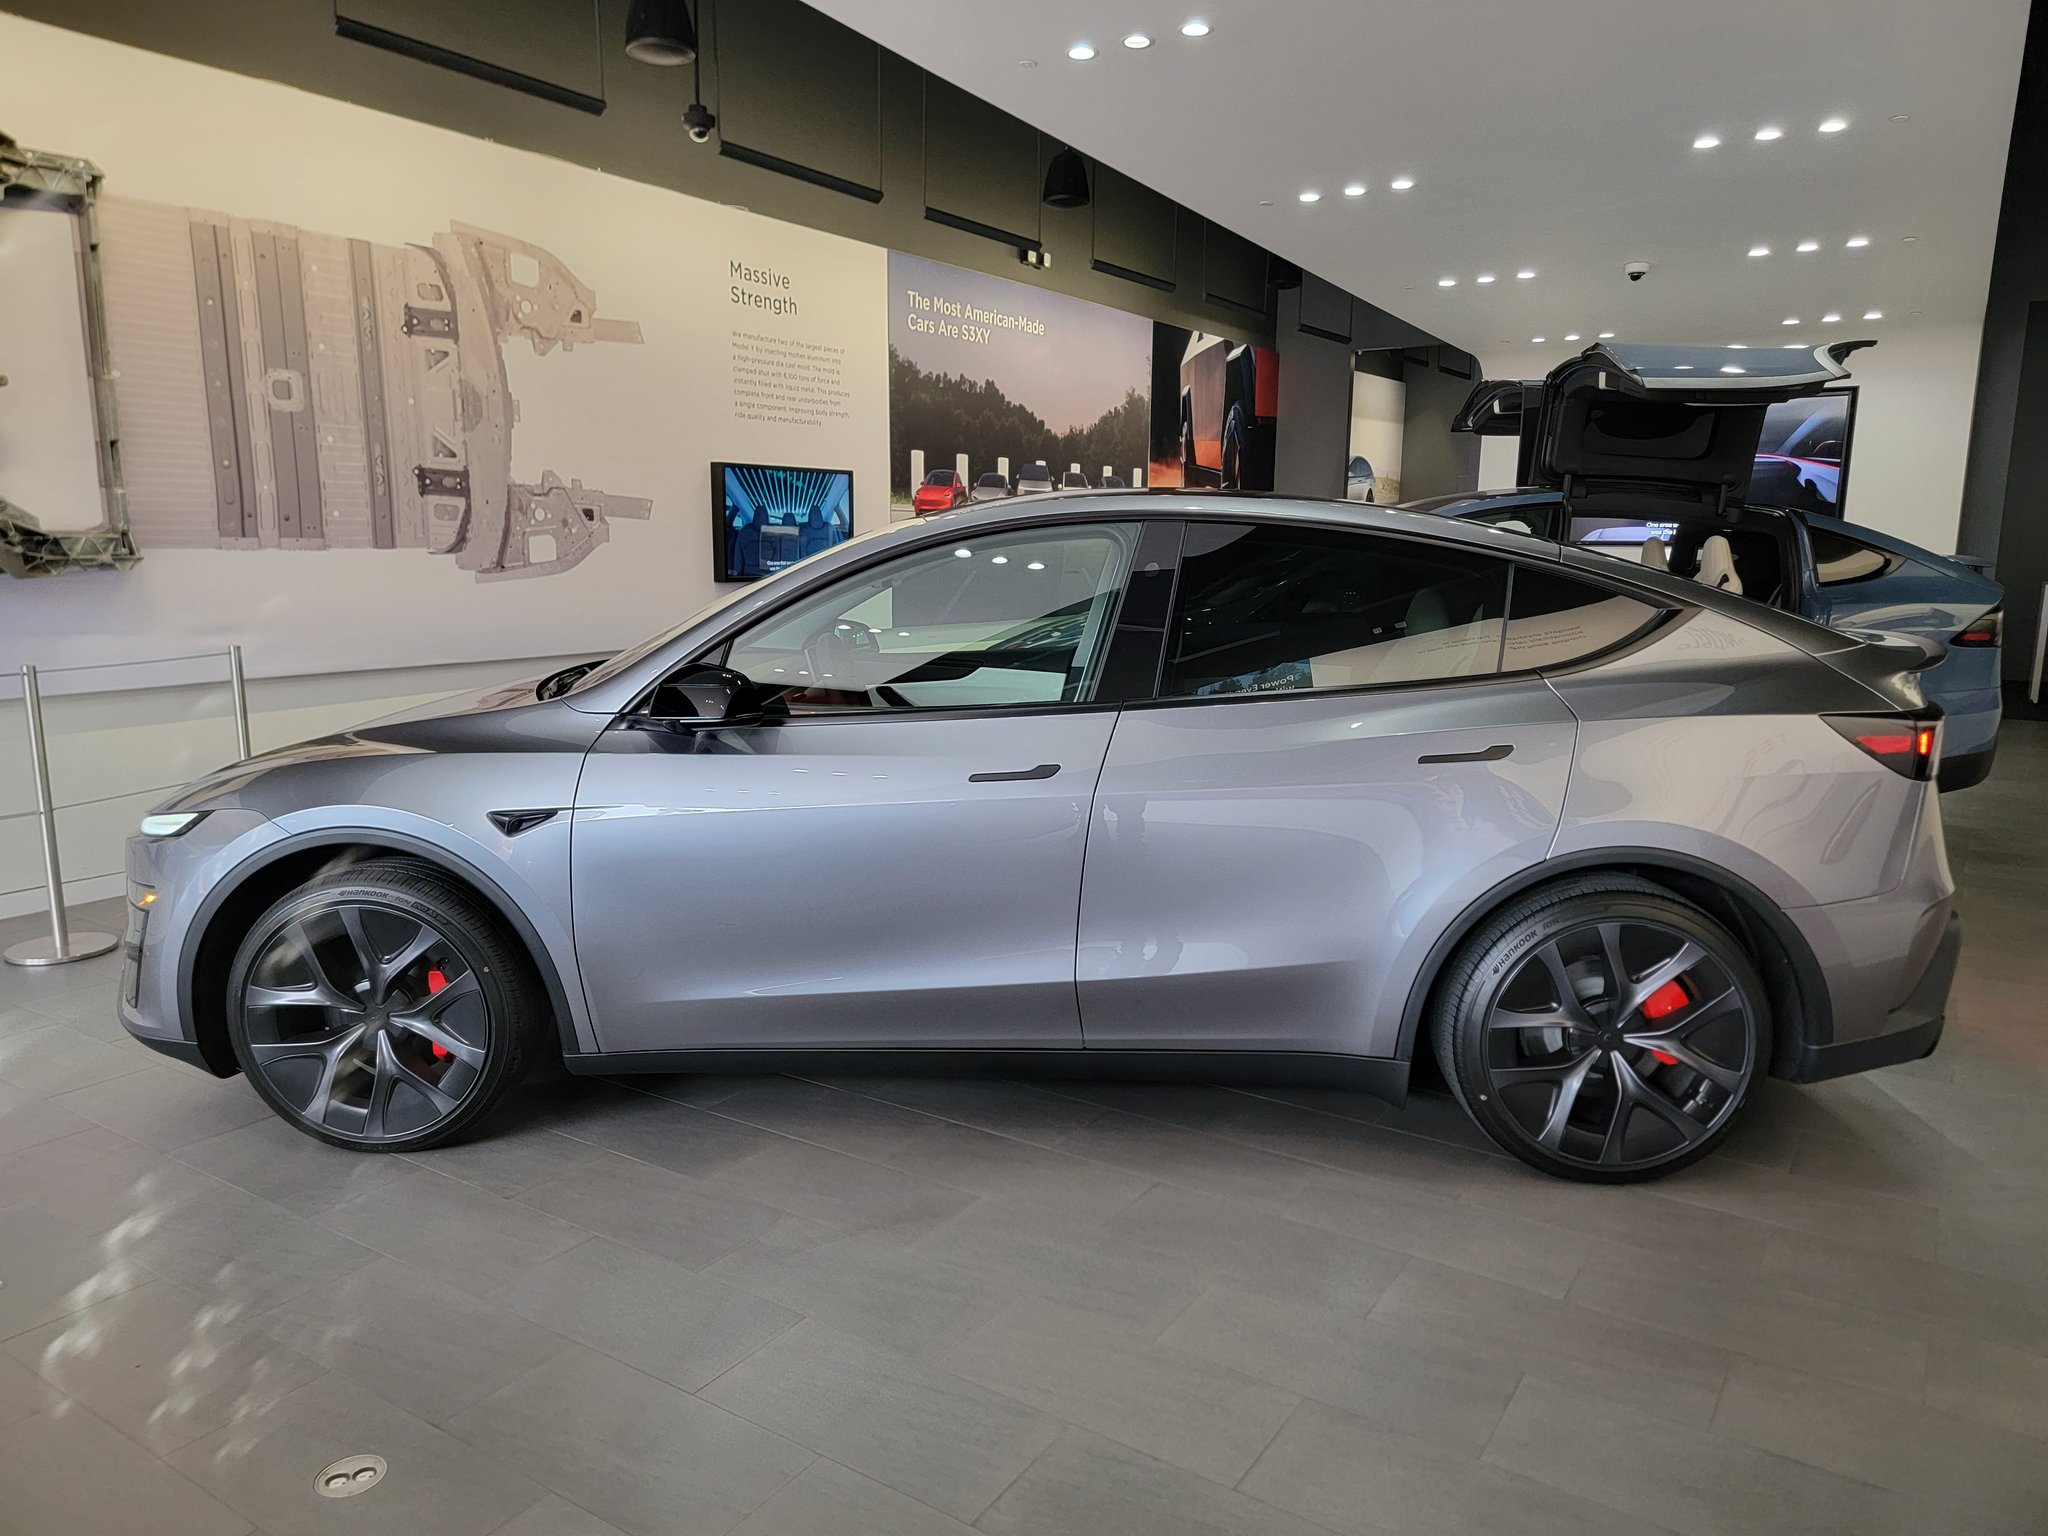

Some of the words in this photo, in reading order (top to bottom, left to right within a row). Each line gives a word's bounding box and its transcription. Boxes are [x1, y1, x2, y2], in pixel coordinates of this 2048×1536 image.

[730, 260, 790, 289] Massive
[731, 286, 797, 315] Strength
[907, 290, 930, 311] The
[934, 296, 962, 317] Most
[964, 304, 1045, 335] American-Made
[908, 314, 935, 334] Cars
[938, 320, 958, 338] Are
[961, 325, 991, 344] S3XY
